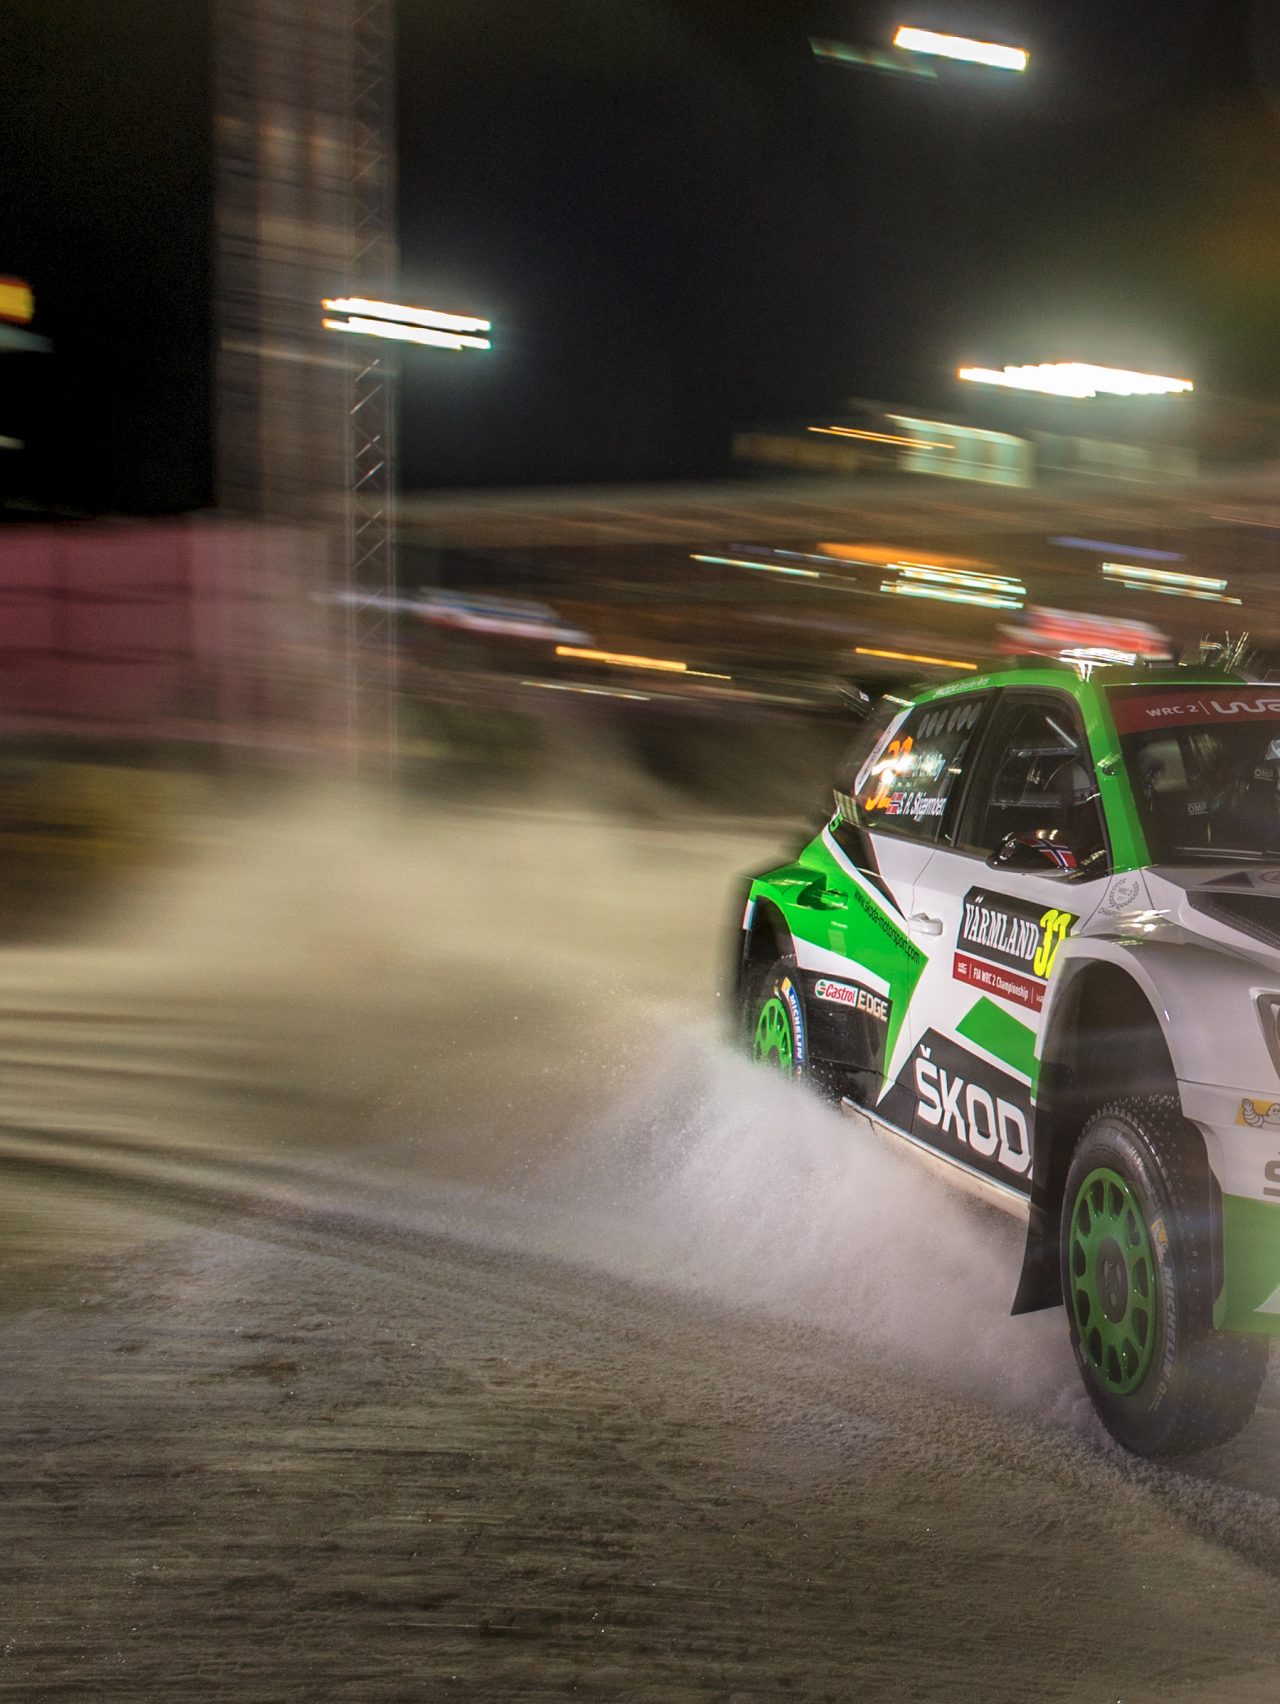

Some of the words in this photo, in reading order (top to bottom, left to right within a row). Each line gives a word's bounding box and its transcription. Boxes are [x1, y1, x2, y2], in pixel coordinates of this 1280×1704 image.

[1145, 704, 1185, 718] WRC
[1186, 703, 1199, 714] 2
[963, 895, 1040, 961] VÄRMLAND
[825, 983, 856, 1004] Castrol
[857, 988, 889, 1022] EDGE
[996, 977, 1029, 1002] Championship
[788, 994, 804, 1060] MICHELIN
[915, 1043, 1033, 1180] ŠKOD
[1161, 1265, 1178, 1379] MICHELIN
